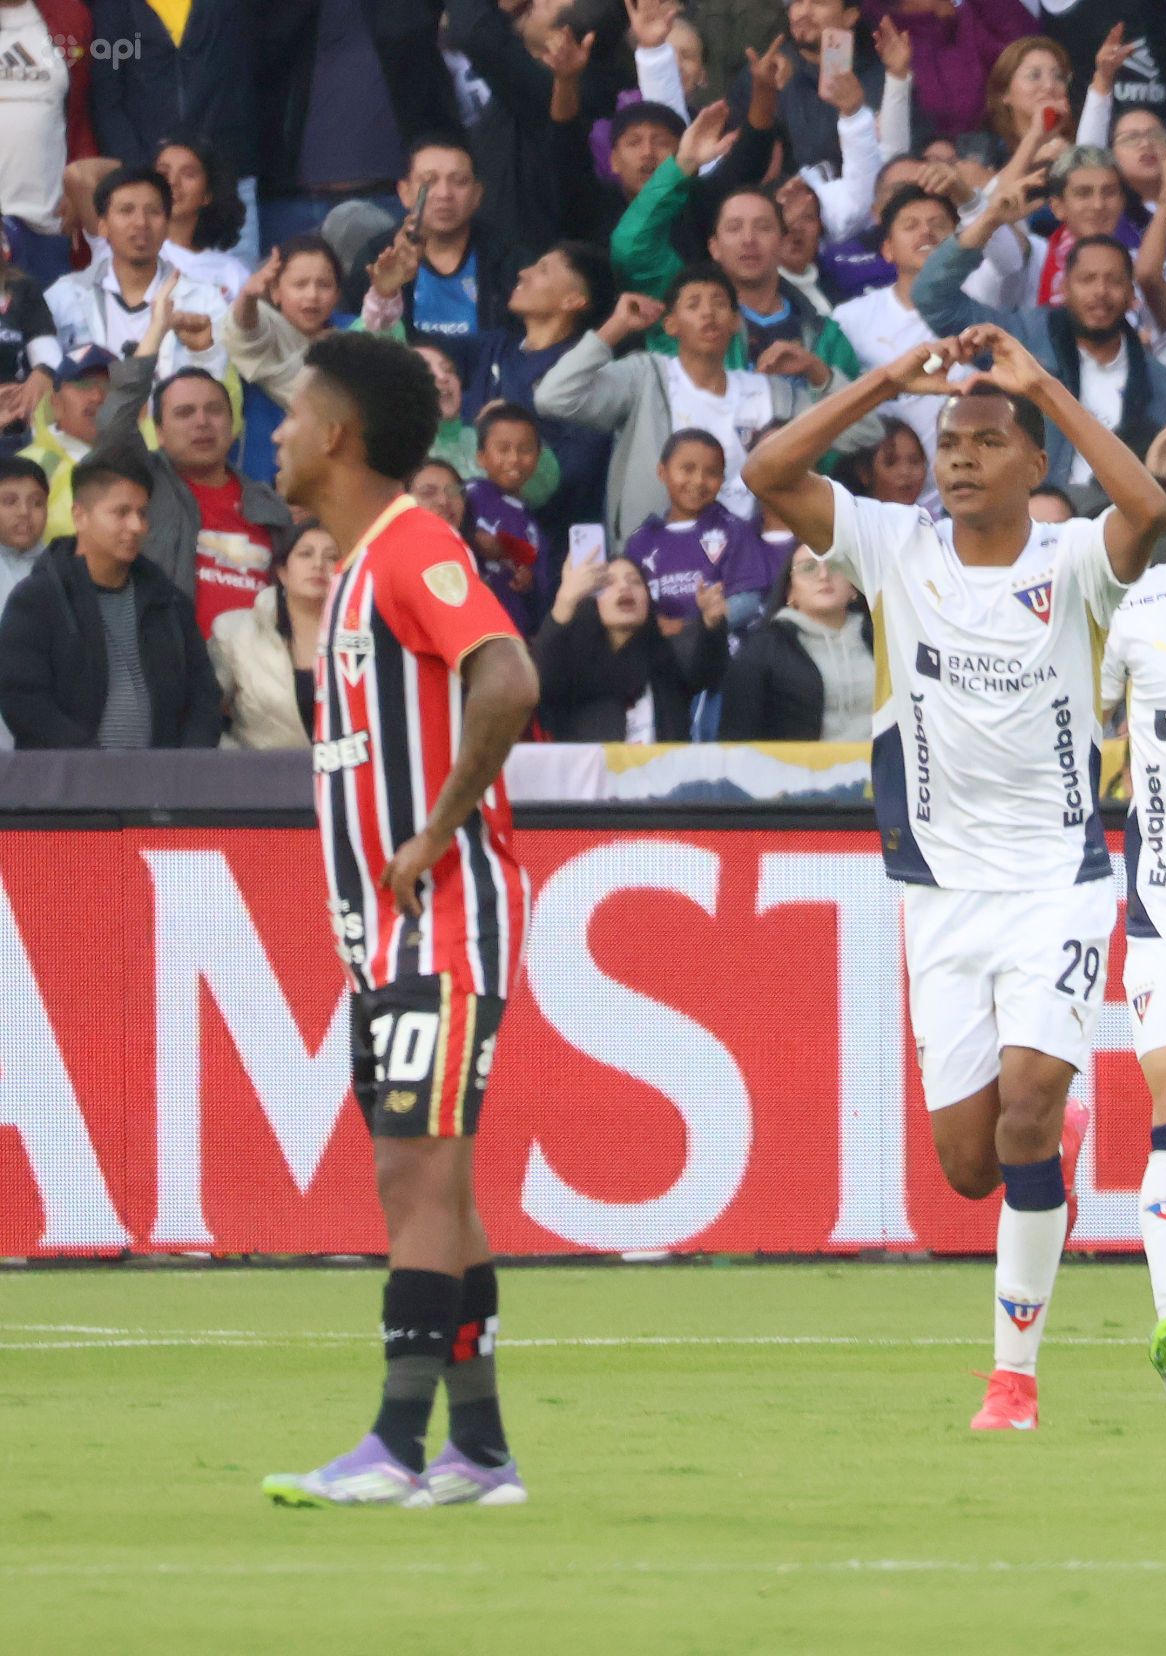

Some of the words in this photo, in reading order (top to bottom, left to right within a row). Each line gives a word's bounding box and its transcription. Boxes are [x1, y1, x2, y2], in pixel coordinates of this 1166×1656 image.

[948, 656, 1023, 675] BANCO
[949, 665, 1058, 692] PICHINCHA
[910, 691, 932, 823] Ecuabet
[1051, 695, 1085, 828] Ecuabet
[1055, 939, 1100, 1001] 29
